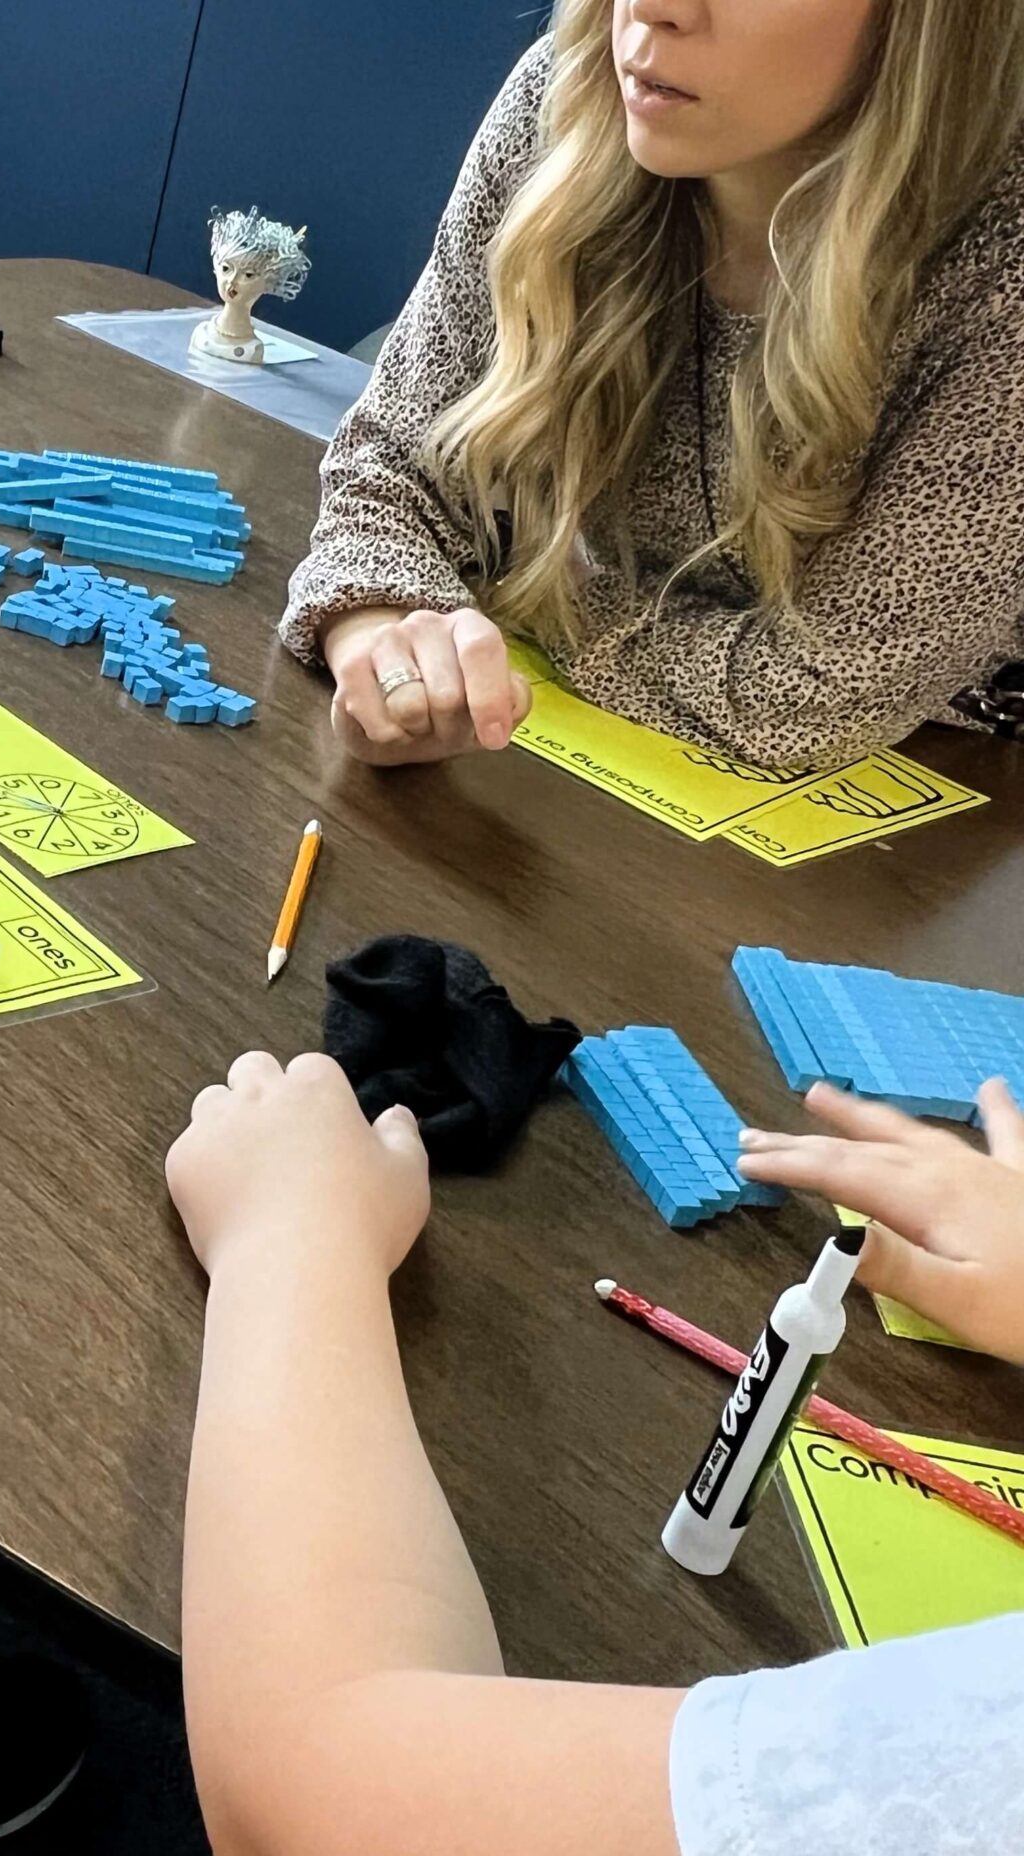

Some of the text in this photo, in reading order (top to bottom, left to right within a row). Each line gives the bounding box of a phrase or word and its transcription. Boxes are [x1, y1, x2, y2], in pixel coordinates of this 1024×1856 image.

[3, 778, 28, 789] 5
[39, 779, 62, 789] 0
[535, 734, 705, 826] Composing on
[78, 792, 104, 801] 7
[101, 809, 126, 819] 3
[50, 838, 76, 850] 2
[91, 839, 113, 850] 4
[17, 924, 77, 971] ones
